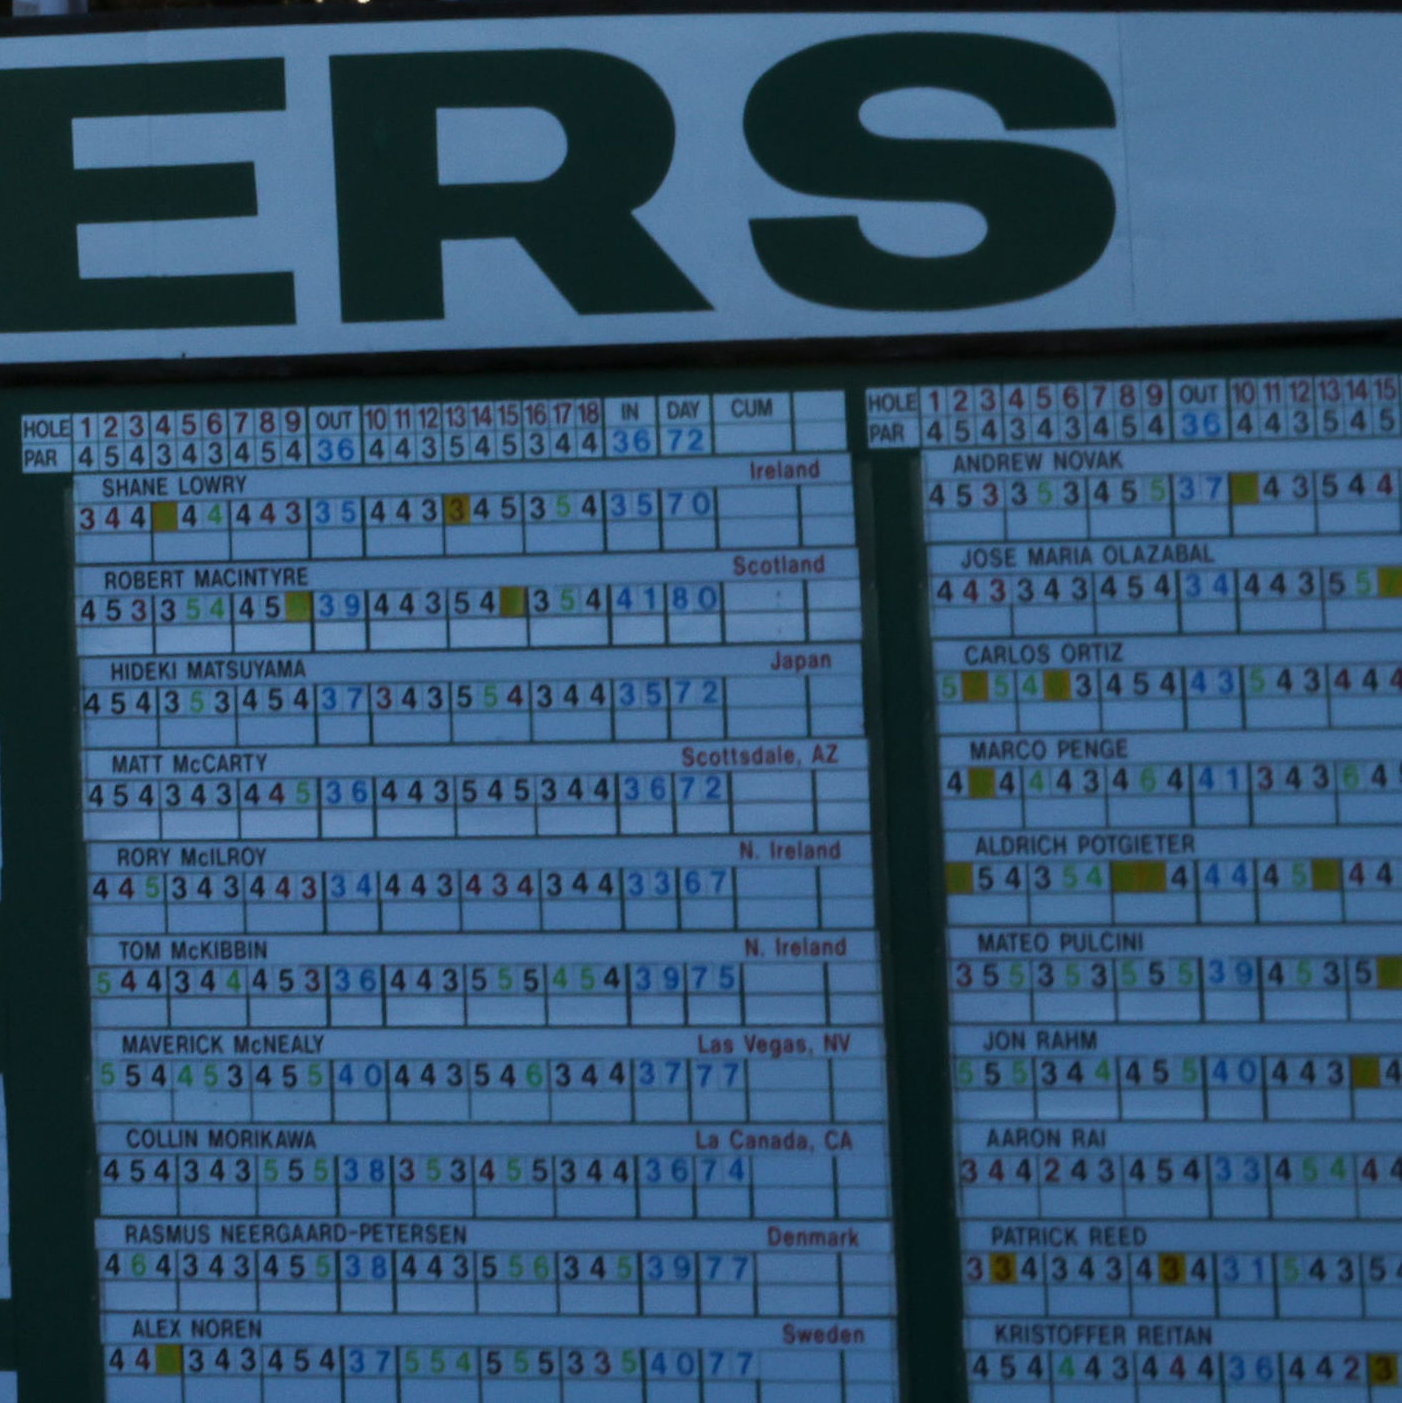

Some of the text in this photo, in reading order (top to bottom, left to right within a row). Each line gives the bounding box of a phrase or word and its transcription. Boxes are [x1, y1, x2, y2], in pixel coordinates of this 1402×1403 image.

[952, 449, 1123, 474] ANDREW NOVAK
[102, 474, 247, 498] SHANE LOWRY
[732, 552, 824, 576] Scotland
[960, 542, 1215, 570] JOSE MARIA OLAZABAL
[104, 566, 307, 590] ROBERT MACINTYRE
[769, 649, 831, 674] Japan
[963, 641, 1123, 666] CARLOS ORTIZ
[110, 658, 306, 681] HIDEKI MATSUYAMA
[969, 737, 1128, 761] MARCO PENGE
[111, 752, 267, 774] MATT McCARTY
[117, 845, 267, 867] RORY McILROY
[974, 832, 1194, 856] ALDRICH POTGIETER
[117, 939, 267, 961] TOM McKIBBIN
[976, 930, 1142, 953] MATEO PULCINI
[121, 1033, 324, 1055] MAVERICK McNEALY
[982, 1028, 1096, 1052] JON RAHM
[125, 1127, 317, 1150] COLLIN MORIKAWA
[985, 1125, 1105, 1149] AARON RAI
[125, 1221, 466, 1245] RASMUS NEERGAARD-PETERSEN
[766, 1225, 859, 1247] Denmark
[991, 1225, 1147, 1248] PATRICK REED
[133, 1316, 261, 1339] ALEX NOREN
[994, 1322, 1212, 1346] KRISTOFFER REITAN
